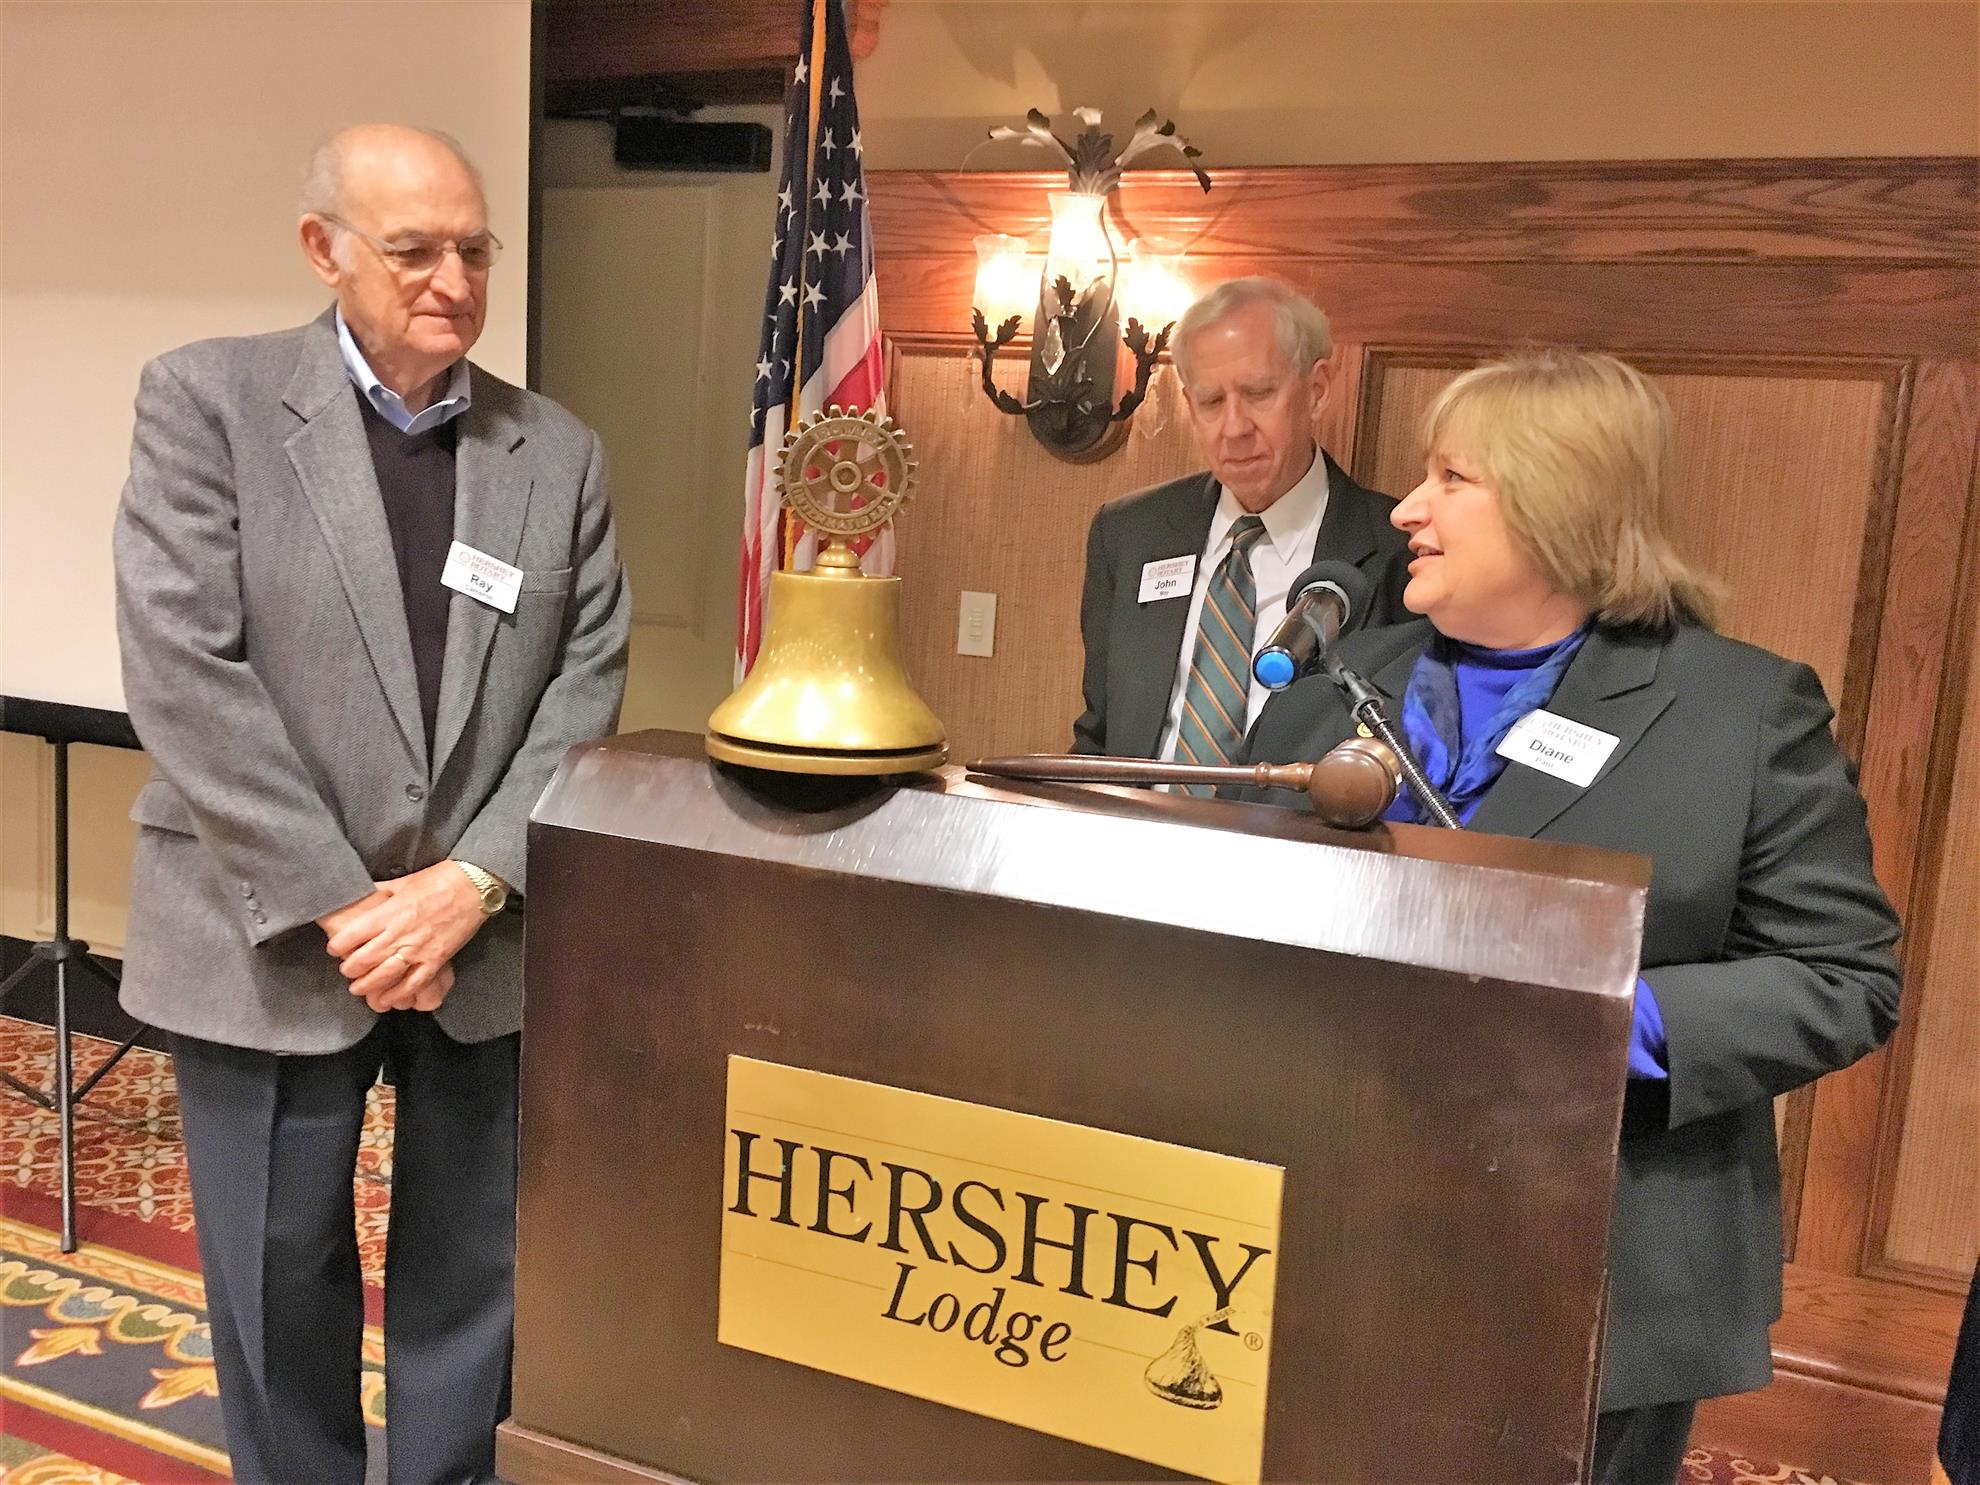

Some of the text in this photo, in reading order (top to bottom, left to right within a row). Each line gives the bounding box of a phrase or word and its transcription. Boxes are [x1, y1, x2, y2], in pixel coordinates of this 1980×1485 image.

[470, 574, 494, 593] Ray
[1154, 579, 1177, 590] John
[1528, 738, 1575, 765] Diane
[728, 1128, 1272, 1337] HERSHEY
[881, 1262, 1072, 1368] Lodge
